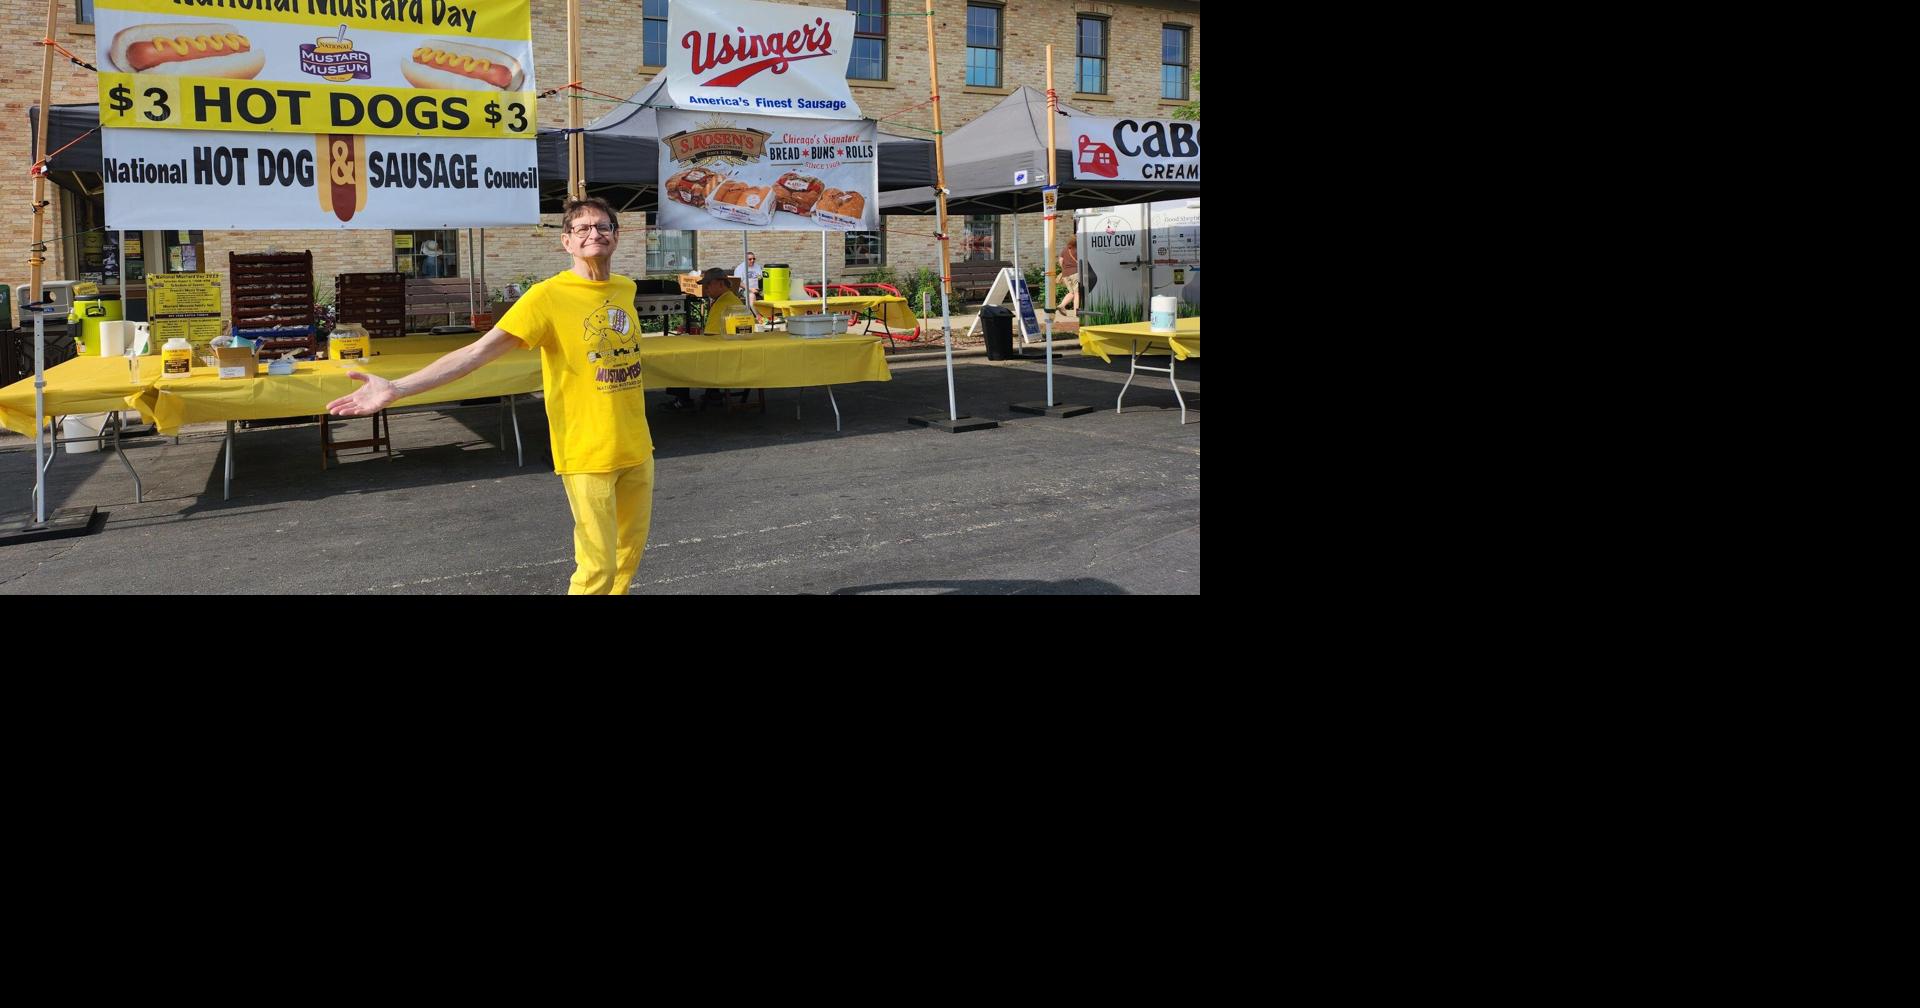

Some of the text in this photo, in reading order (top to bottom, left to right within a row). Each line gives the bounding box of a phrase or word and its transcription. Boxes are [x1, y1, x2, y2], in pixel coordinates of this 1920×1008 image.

[307, 0, 424, 25] Mustard
[431, 0, 477, 33] Day
[320, 42, 351, 50] NATIONAL
[681, 17, 832, 75] Usinger's
[302, 49, 368, 63] MUSTARD
[303, 63, 369, 75] MUSEUM
[194, 86, 311, 125] HOT
[329, 92, 470, 131] DOGS
[689, 95, 847, 111] America's Finest Sausage
[783, 133, 860, 146] Chicago's Signature
[769, 145, 874, 160] BREAD BUNS ROLLS
[104, 140, 538, 189] National HOT DOG & SAUSAGE Council
[1141, 163, 1199, 179] CREAM
[1091, 234, 1136, 248] HOLY COW
